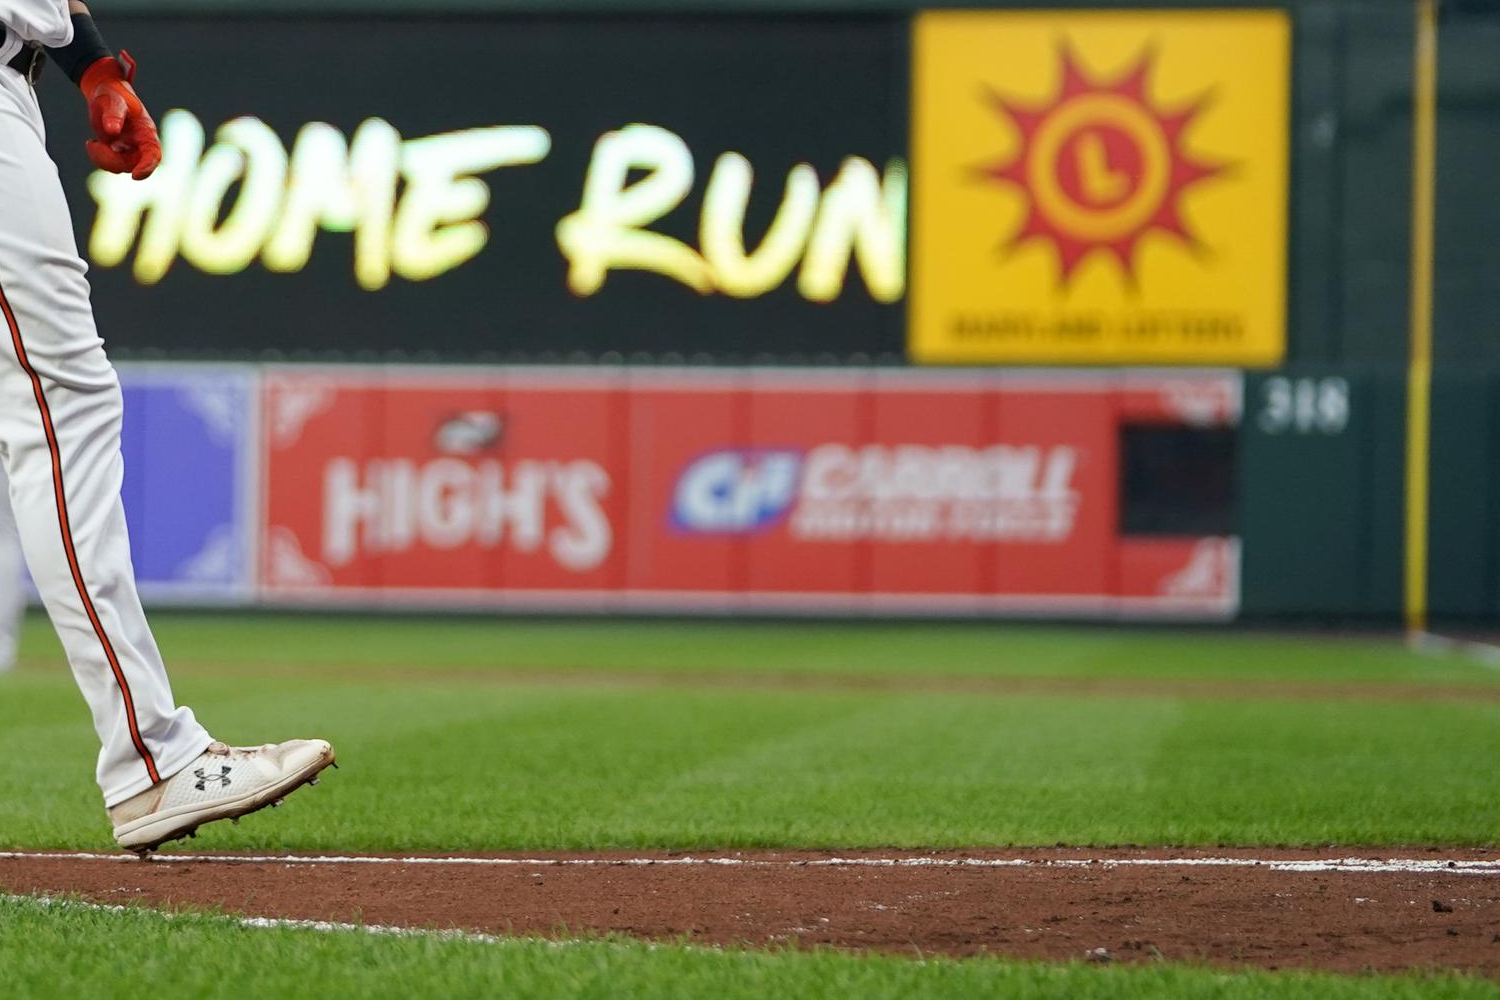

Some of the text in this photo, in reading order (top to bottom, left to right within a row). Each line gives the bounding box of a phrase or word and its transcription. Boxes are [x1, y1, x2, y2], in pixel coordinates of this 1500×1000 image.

[87, 108, 908, 303] HOME RUN
[321, 456, 614, 572] HIGH'S
